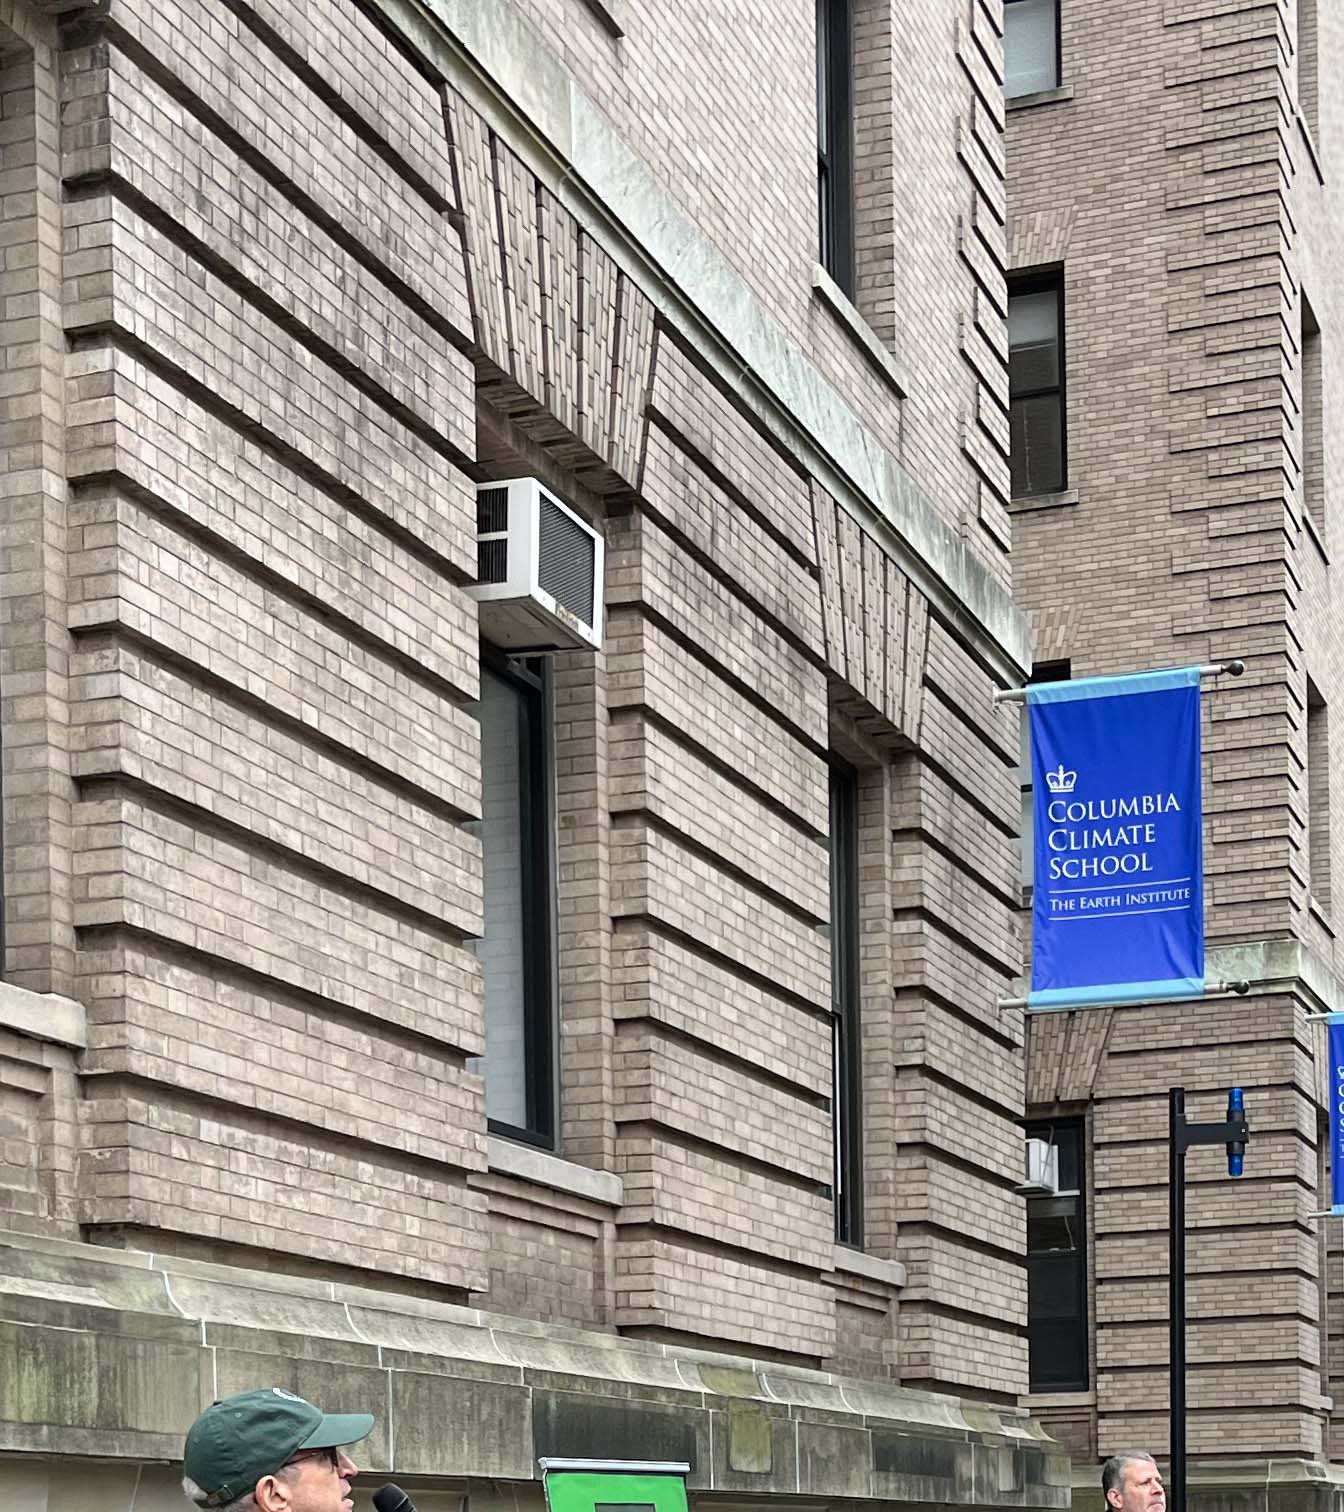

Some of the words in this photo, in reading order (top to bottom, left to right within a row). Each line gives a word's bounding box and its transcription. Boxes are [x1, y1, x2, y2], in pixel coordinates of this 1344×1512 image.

[1048, 793, 1181, 823] COLUMBIA
[1048, 824, 1156, 851] CLIMATE
[1049, 853, 1153, 880] SCHOOL
[1050, 899, 1075, 911] THE
[1080, 895, 1121, 909] EARTH
[1126, 888, 1190, 905] INSTITUTE
